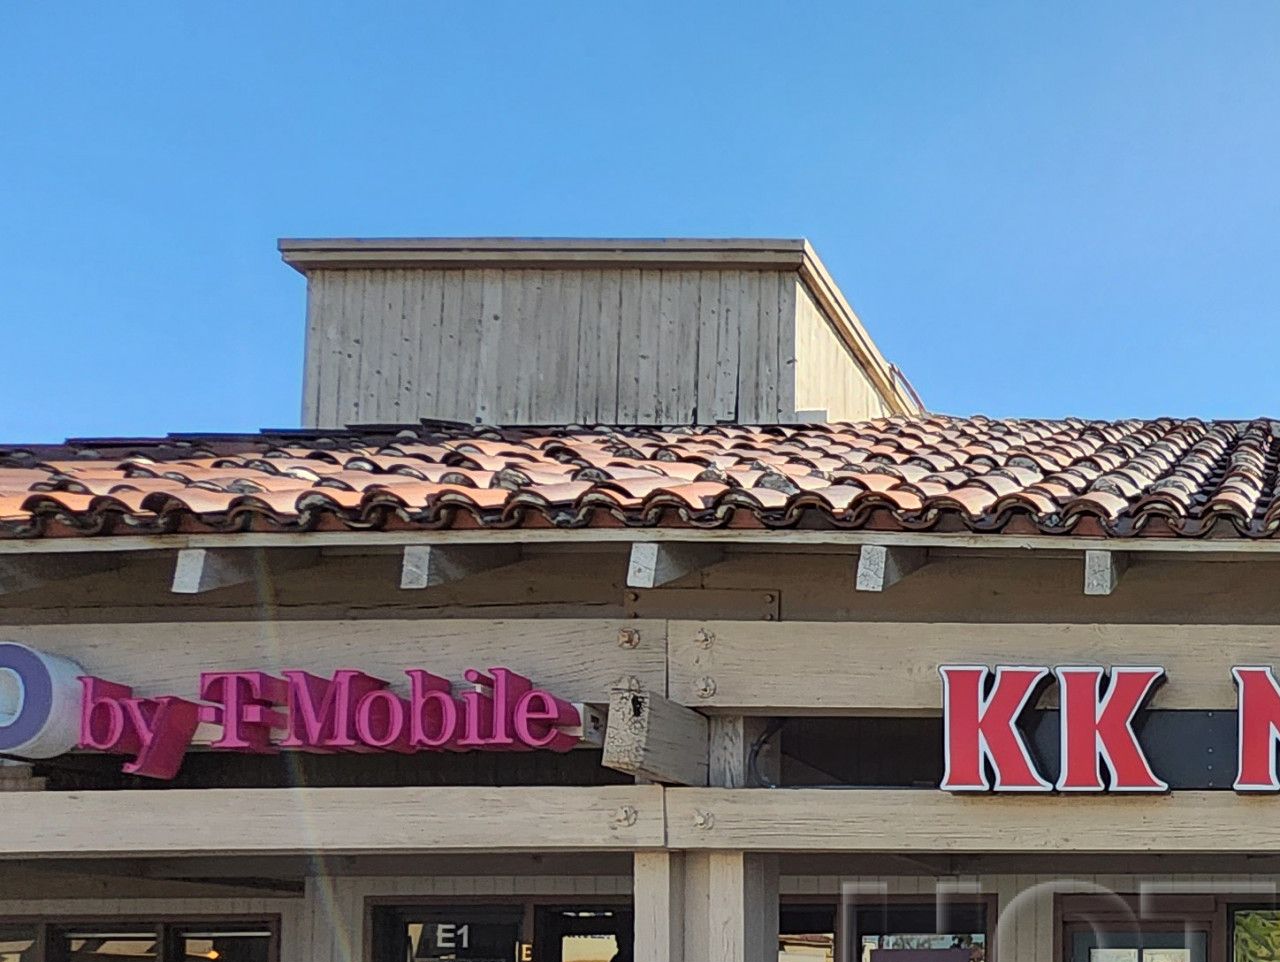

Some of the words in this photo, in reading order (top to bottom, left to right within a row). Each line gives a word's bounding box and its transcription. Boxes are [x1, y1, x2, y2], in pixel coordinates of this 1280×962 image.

[78, 675, 169, 775] by
[939, 665, 1168, 793] KK
[436, 923, 470, 948] E1
